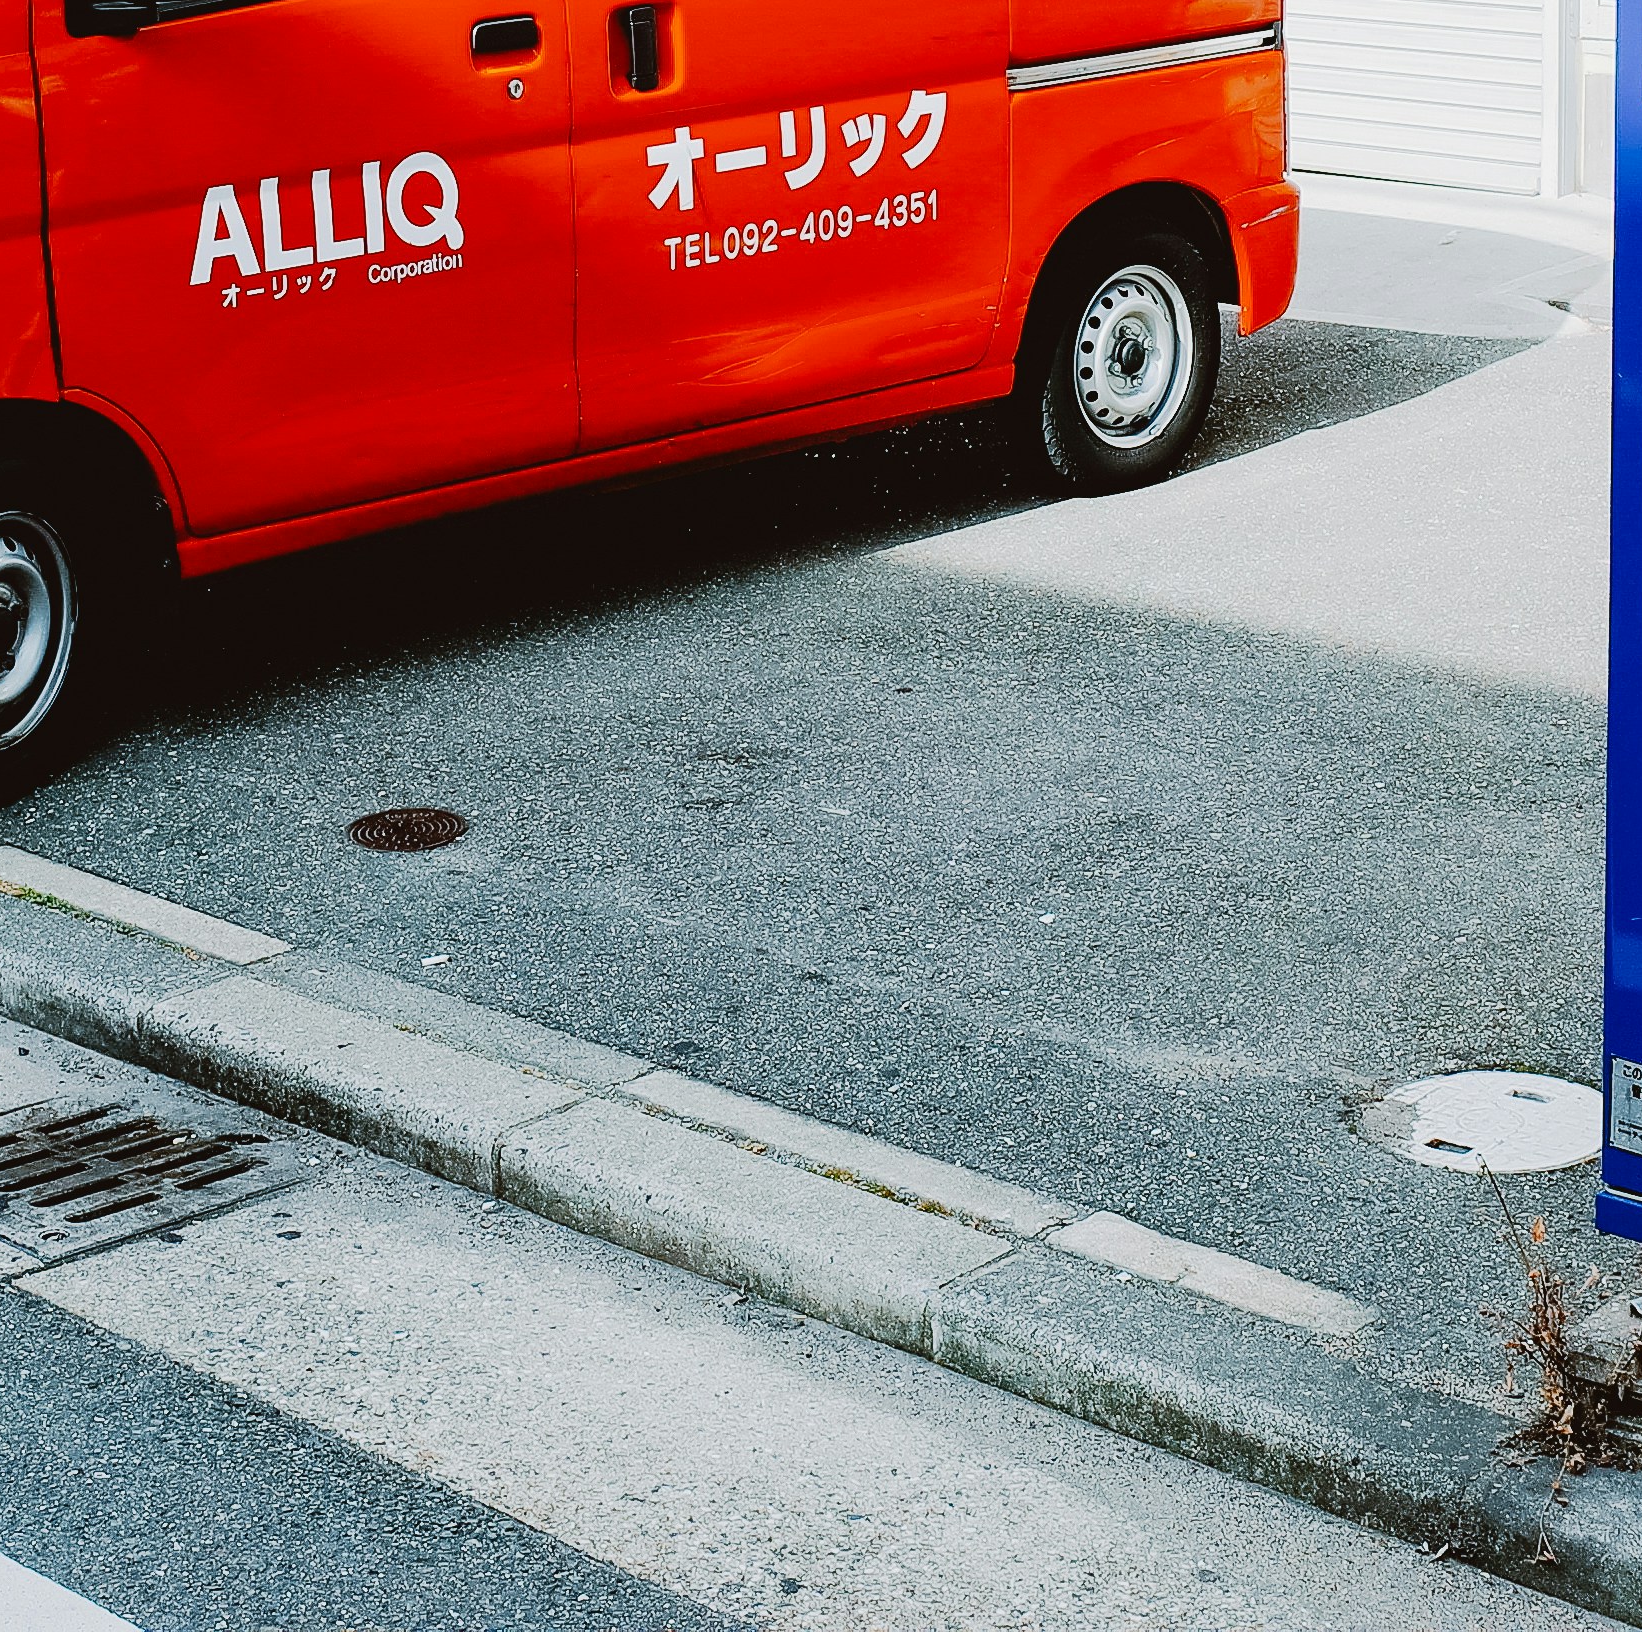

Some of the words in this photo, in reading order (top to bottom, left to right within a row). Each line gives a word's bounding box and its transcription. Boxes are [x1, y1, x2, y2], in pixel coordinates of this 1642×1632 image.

[645, 89, 949, 213] オーリック
[187, 150, 466, 287] ALLIQ
[664, 189, 941, 272] TEL092-409-4351
[220, 266, 337, 309] オーリック
[366, 252, 464, 285] Corporation
